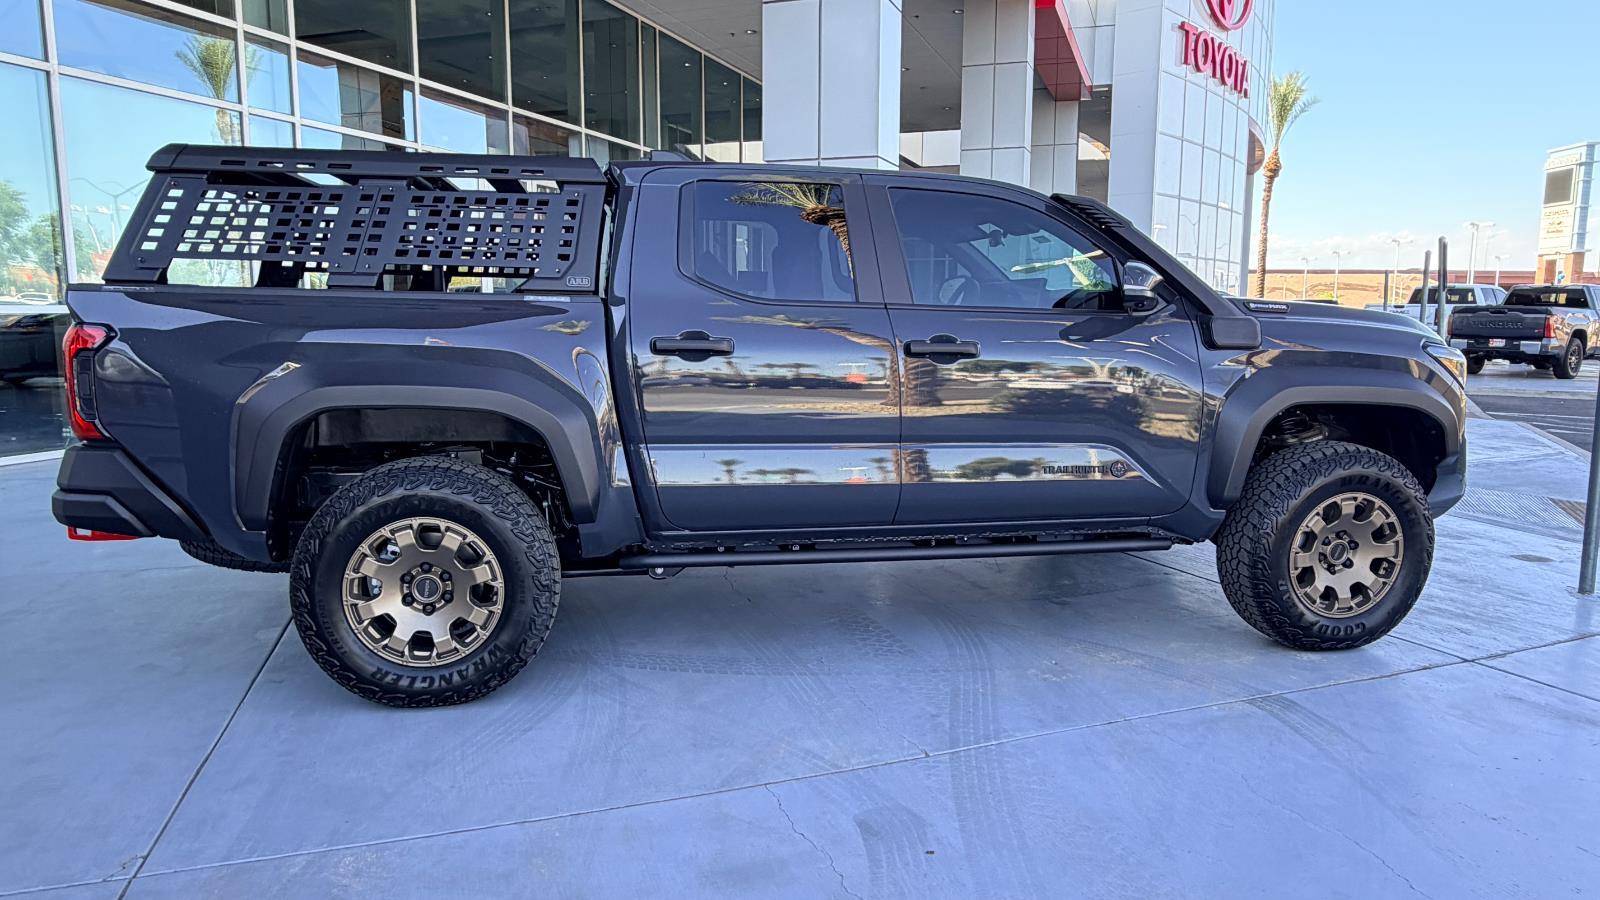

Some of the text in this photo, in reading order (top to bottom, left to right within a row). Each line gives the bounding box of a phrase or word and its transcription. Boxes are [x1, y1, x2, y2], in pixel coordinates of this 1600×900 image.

[1178, 21, 1248, 99] TOYOTA
[569, 277, 589, 286] ARB
[369, 642, 504, 689] WRANGLER
